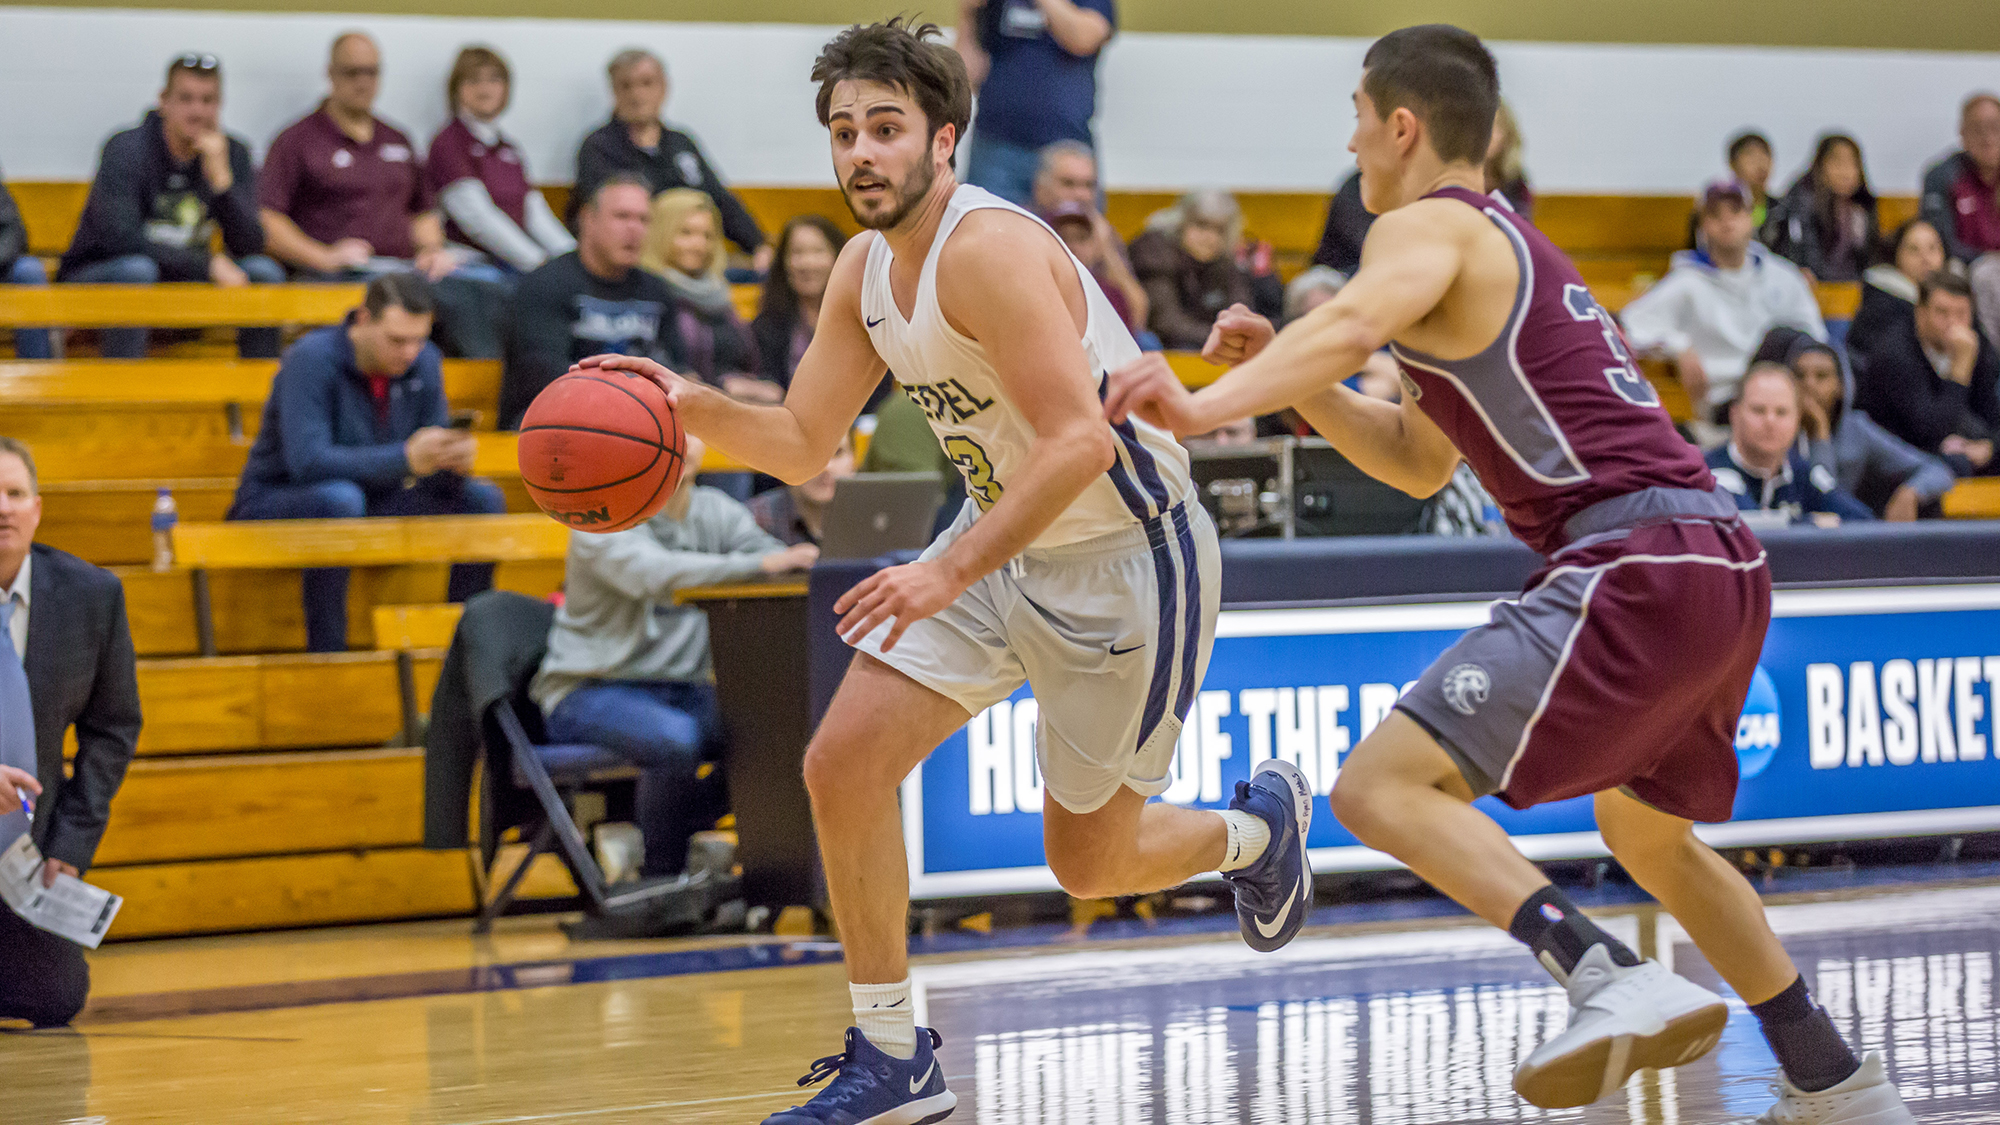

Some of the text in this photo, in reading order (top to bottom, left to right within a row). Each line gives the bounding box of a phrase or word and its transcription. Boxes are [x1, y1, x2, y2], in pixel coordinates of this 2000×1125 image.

[967, 697, 1045, 816] HO
[1239, 684, 1349, 797] THE
[1735, 712, 1781, 751] CAA
